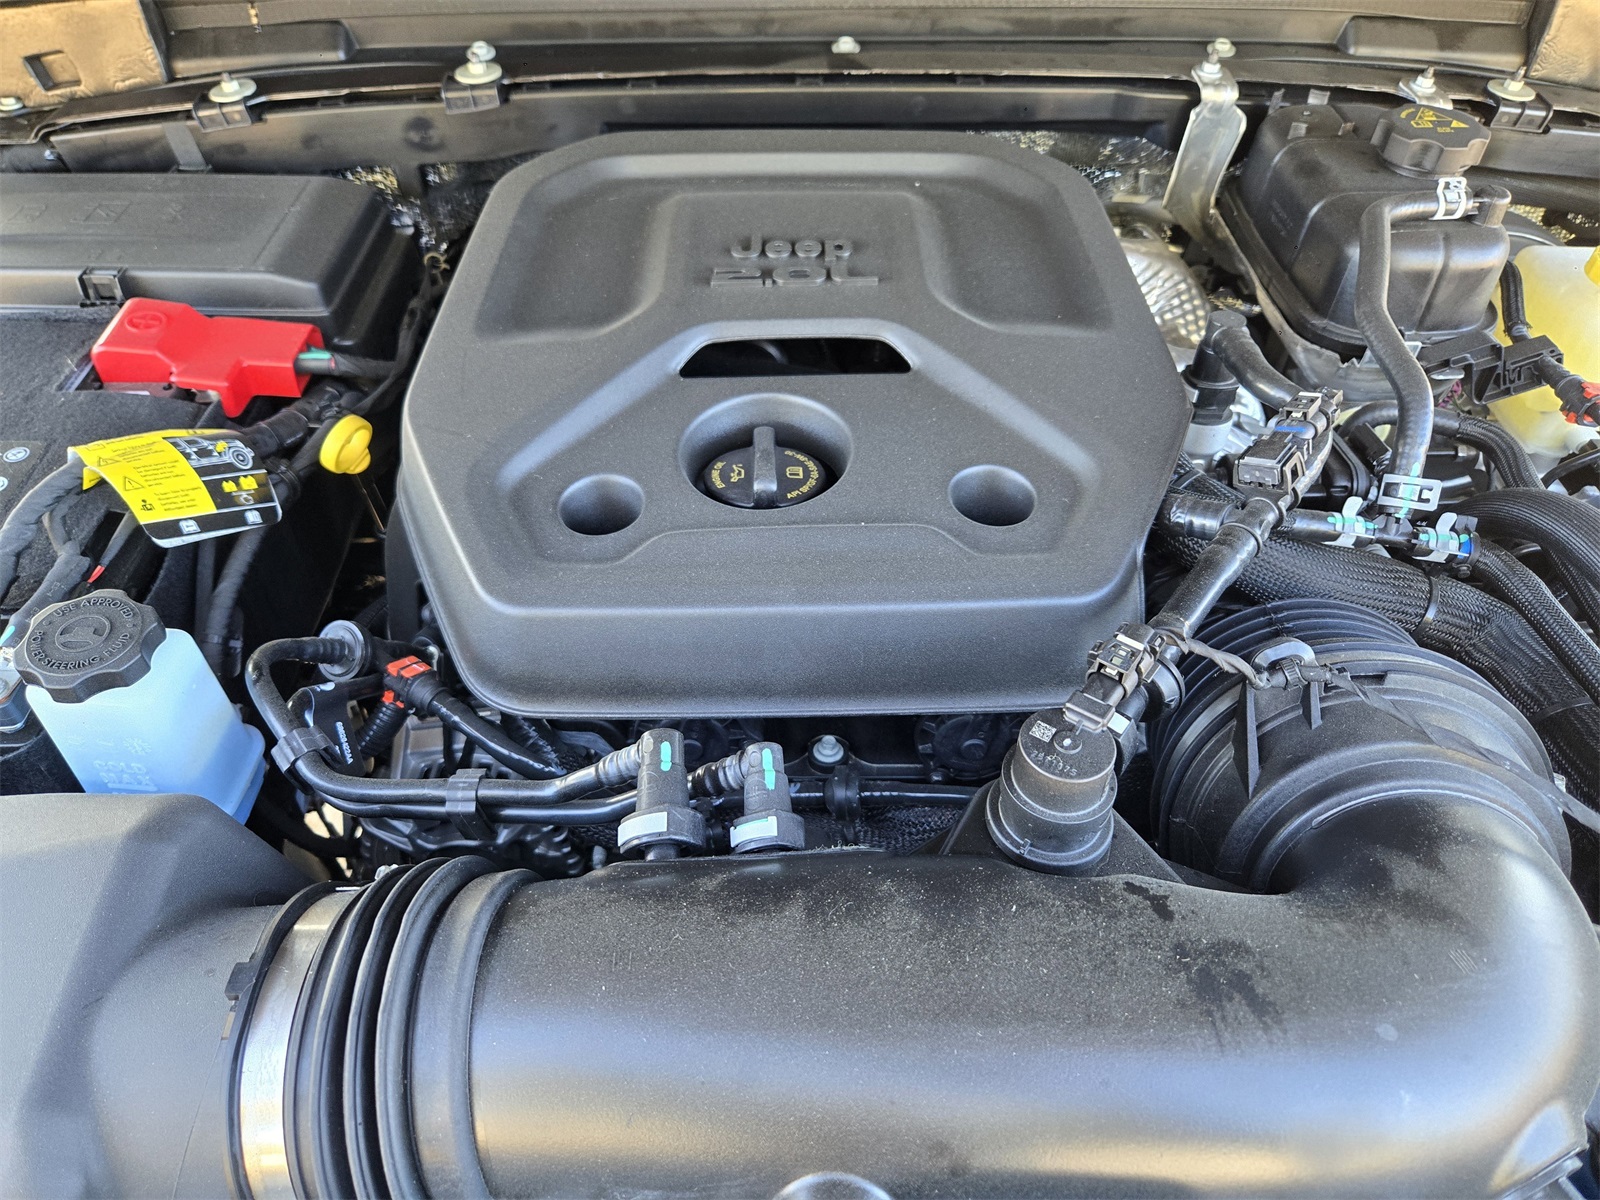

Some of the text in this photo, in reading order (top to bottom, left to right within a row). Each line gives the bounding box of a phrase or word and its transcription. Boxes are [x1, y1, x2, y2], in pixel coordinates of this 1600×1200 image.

[731, 231, 852, 265] Jeep
[711, 266, 879, 288] 2.0L
[711, 469, 726, 489] ENGINE
[53, 602, 77, 617] USE
[81, 597, 134, 619] APPROVED
[30, 629, 131, 670] POWER STEERING FLUID
[93, 760, 147, 774] COLD
